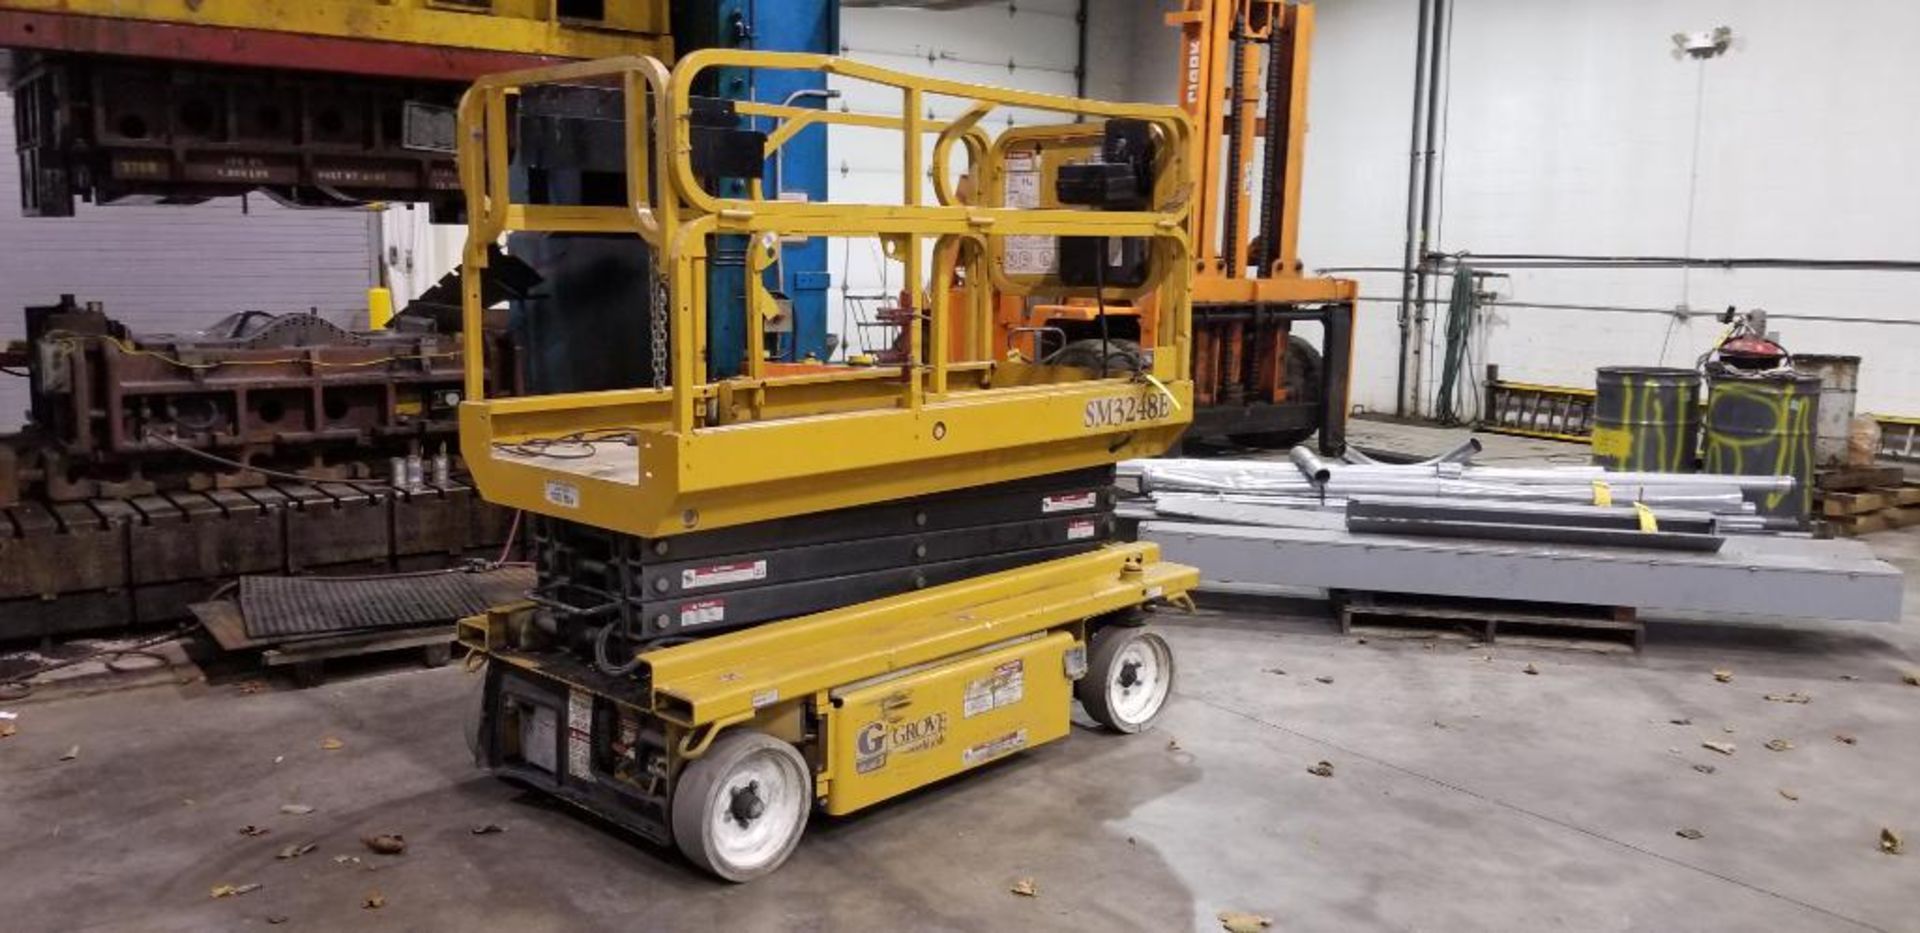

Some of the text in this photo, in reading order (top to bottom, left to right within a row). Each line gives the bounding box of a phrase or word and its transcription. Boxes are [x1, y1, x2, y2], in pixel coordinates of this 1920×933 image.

[1187, 41, 1201, 103] CLARK
[1085, 393, 1169, 427] SM3248E
[892, 713, 947, 745] GROVE
